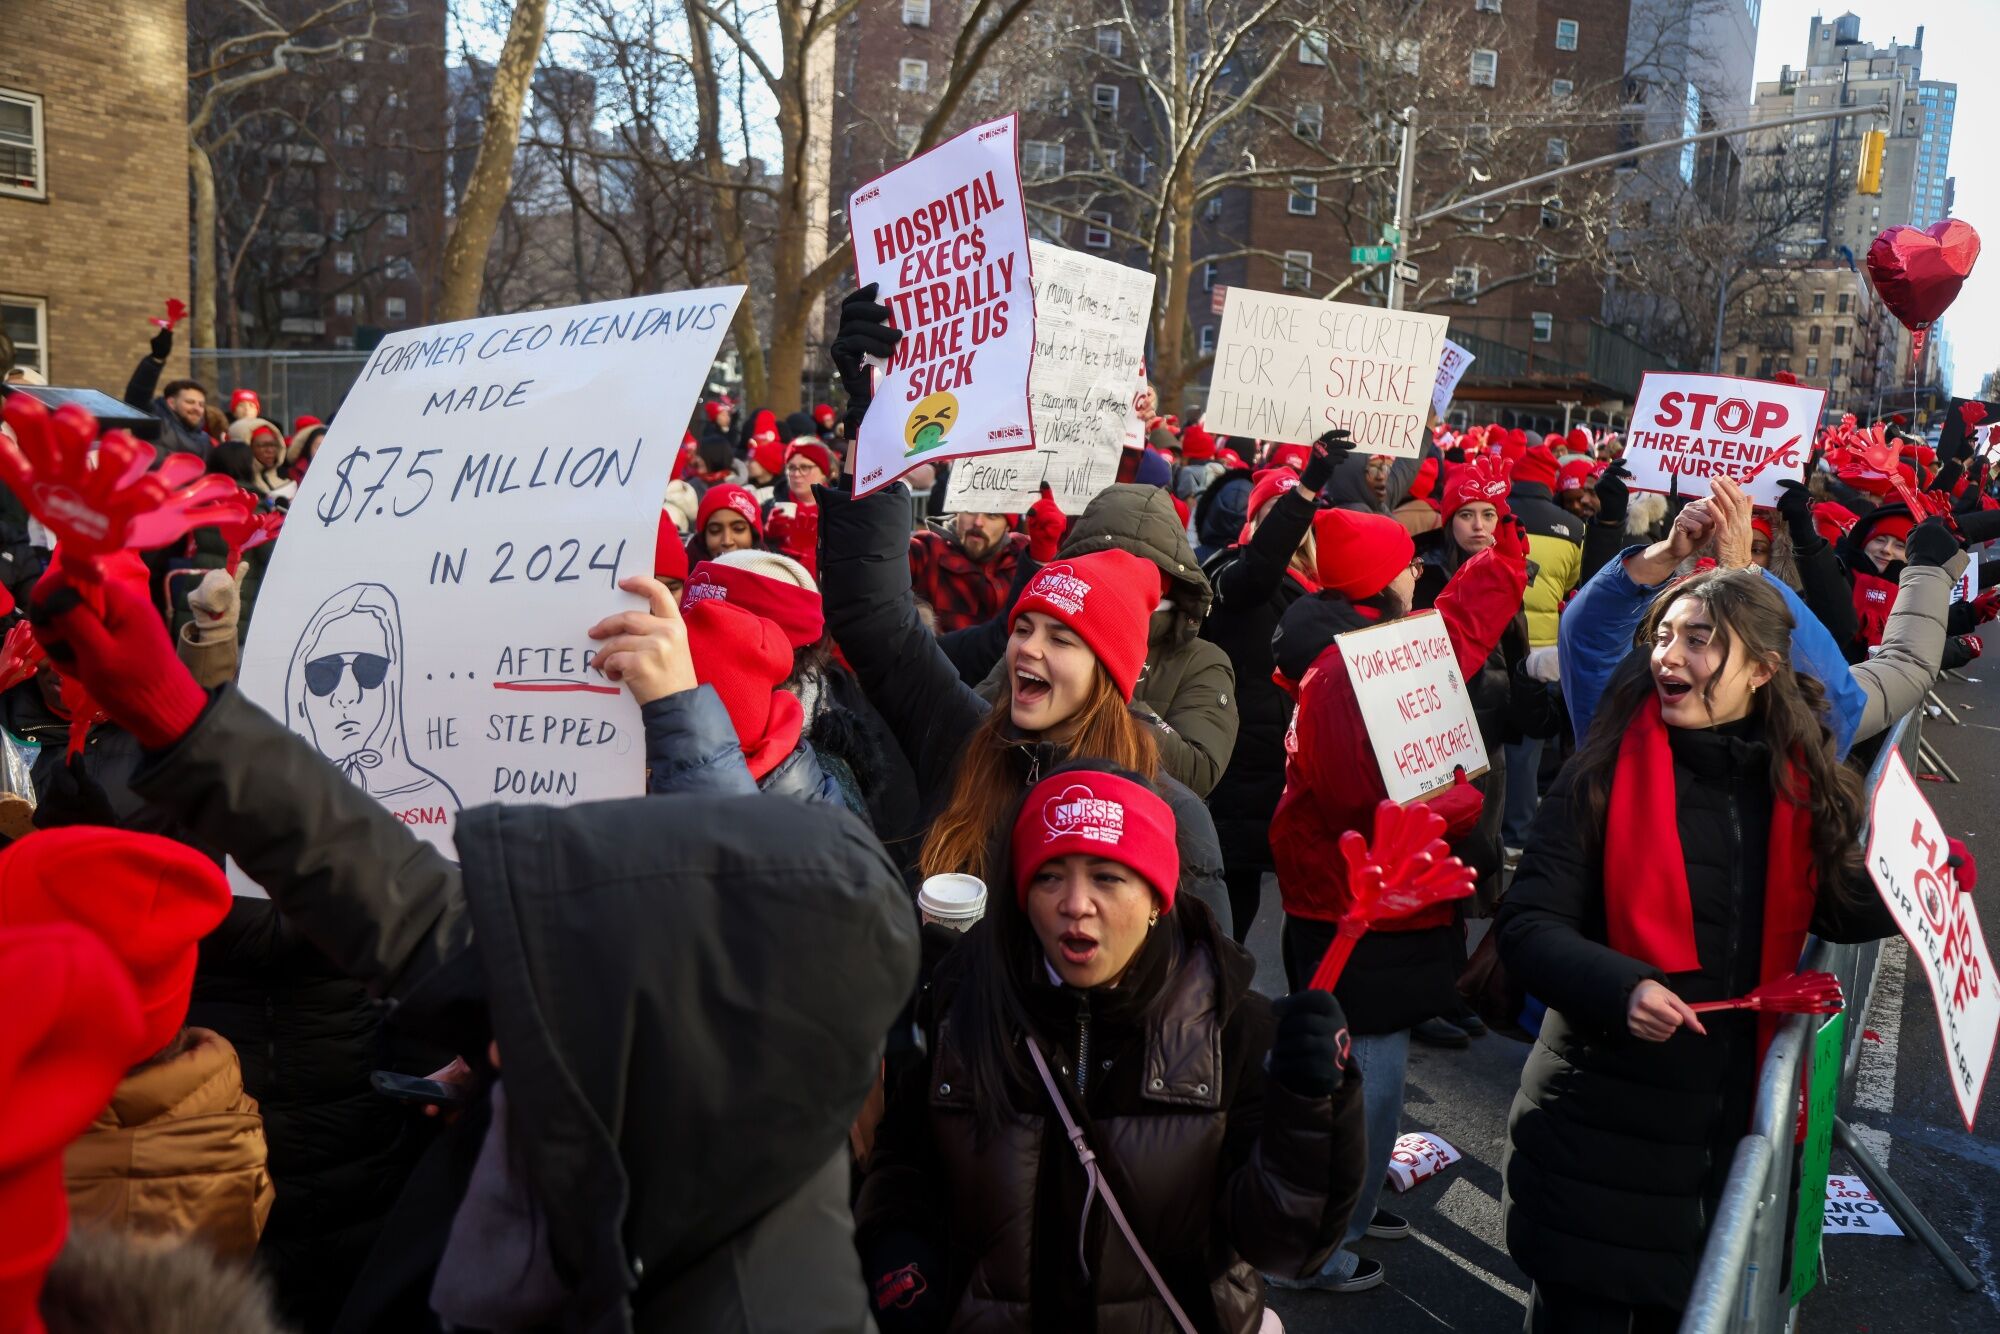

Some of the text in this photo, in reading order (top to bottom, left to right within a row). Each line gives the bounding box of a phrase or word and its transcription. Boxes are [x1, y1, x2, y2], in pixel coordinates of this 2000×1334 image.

[873, 170, 1005, 266] HOSPITAL
[899, 224, 987, 289] EXEC$
[884, 252, 1015, 333] ITERALLY
[366, 331, 475, 383] FORMER
[477, 323, 553, 360] CEO
[886, 300, 1009, 377] MAKE US
[1235, 300, 1444, 365] MORE SECURITY
[422, 379, 535, 417] MADE
[906, 350, 978, 402] SICK
[1223, 344, 1419, 406] FOR A STRIKE
[1082, 387, 1093, 412] 6
[1218, 390, 1420, 451] THAN A SHOOTER
[1654, 391, 1790, 439] STOP
[957, 455, 1019, 494] Because
[1028, 450, 1059, 495] I
[1632, 430, 1800, 469] THREATENING
[1658, 455, 1756, 485] NURSES
[316, 437, 643, 528] $7.5 MILLION
[430, 538, 627, 590] IN 2024
[1040, 574, 1089, 598] NURSES
[496, 646, 605, 679] AFTER
[1349, 649, 1390, 684] YOUR
[1396, 684, 1443, 726] NEEDS
[427, 714, 617, 751] HE STEPPED
[1394, 717, 1479, 781] HEALTHCARE!
[493, 766, 578, 797] DOWN
[1055, 816, 1123, 829] ASSOCIATION
[1056, 802, 1124, 823] NURSES
[1879, 855, 1974, 1096] OUR HEALTHCARE
